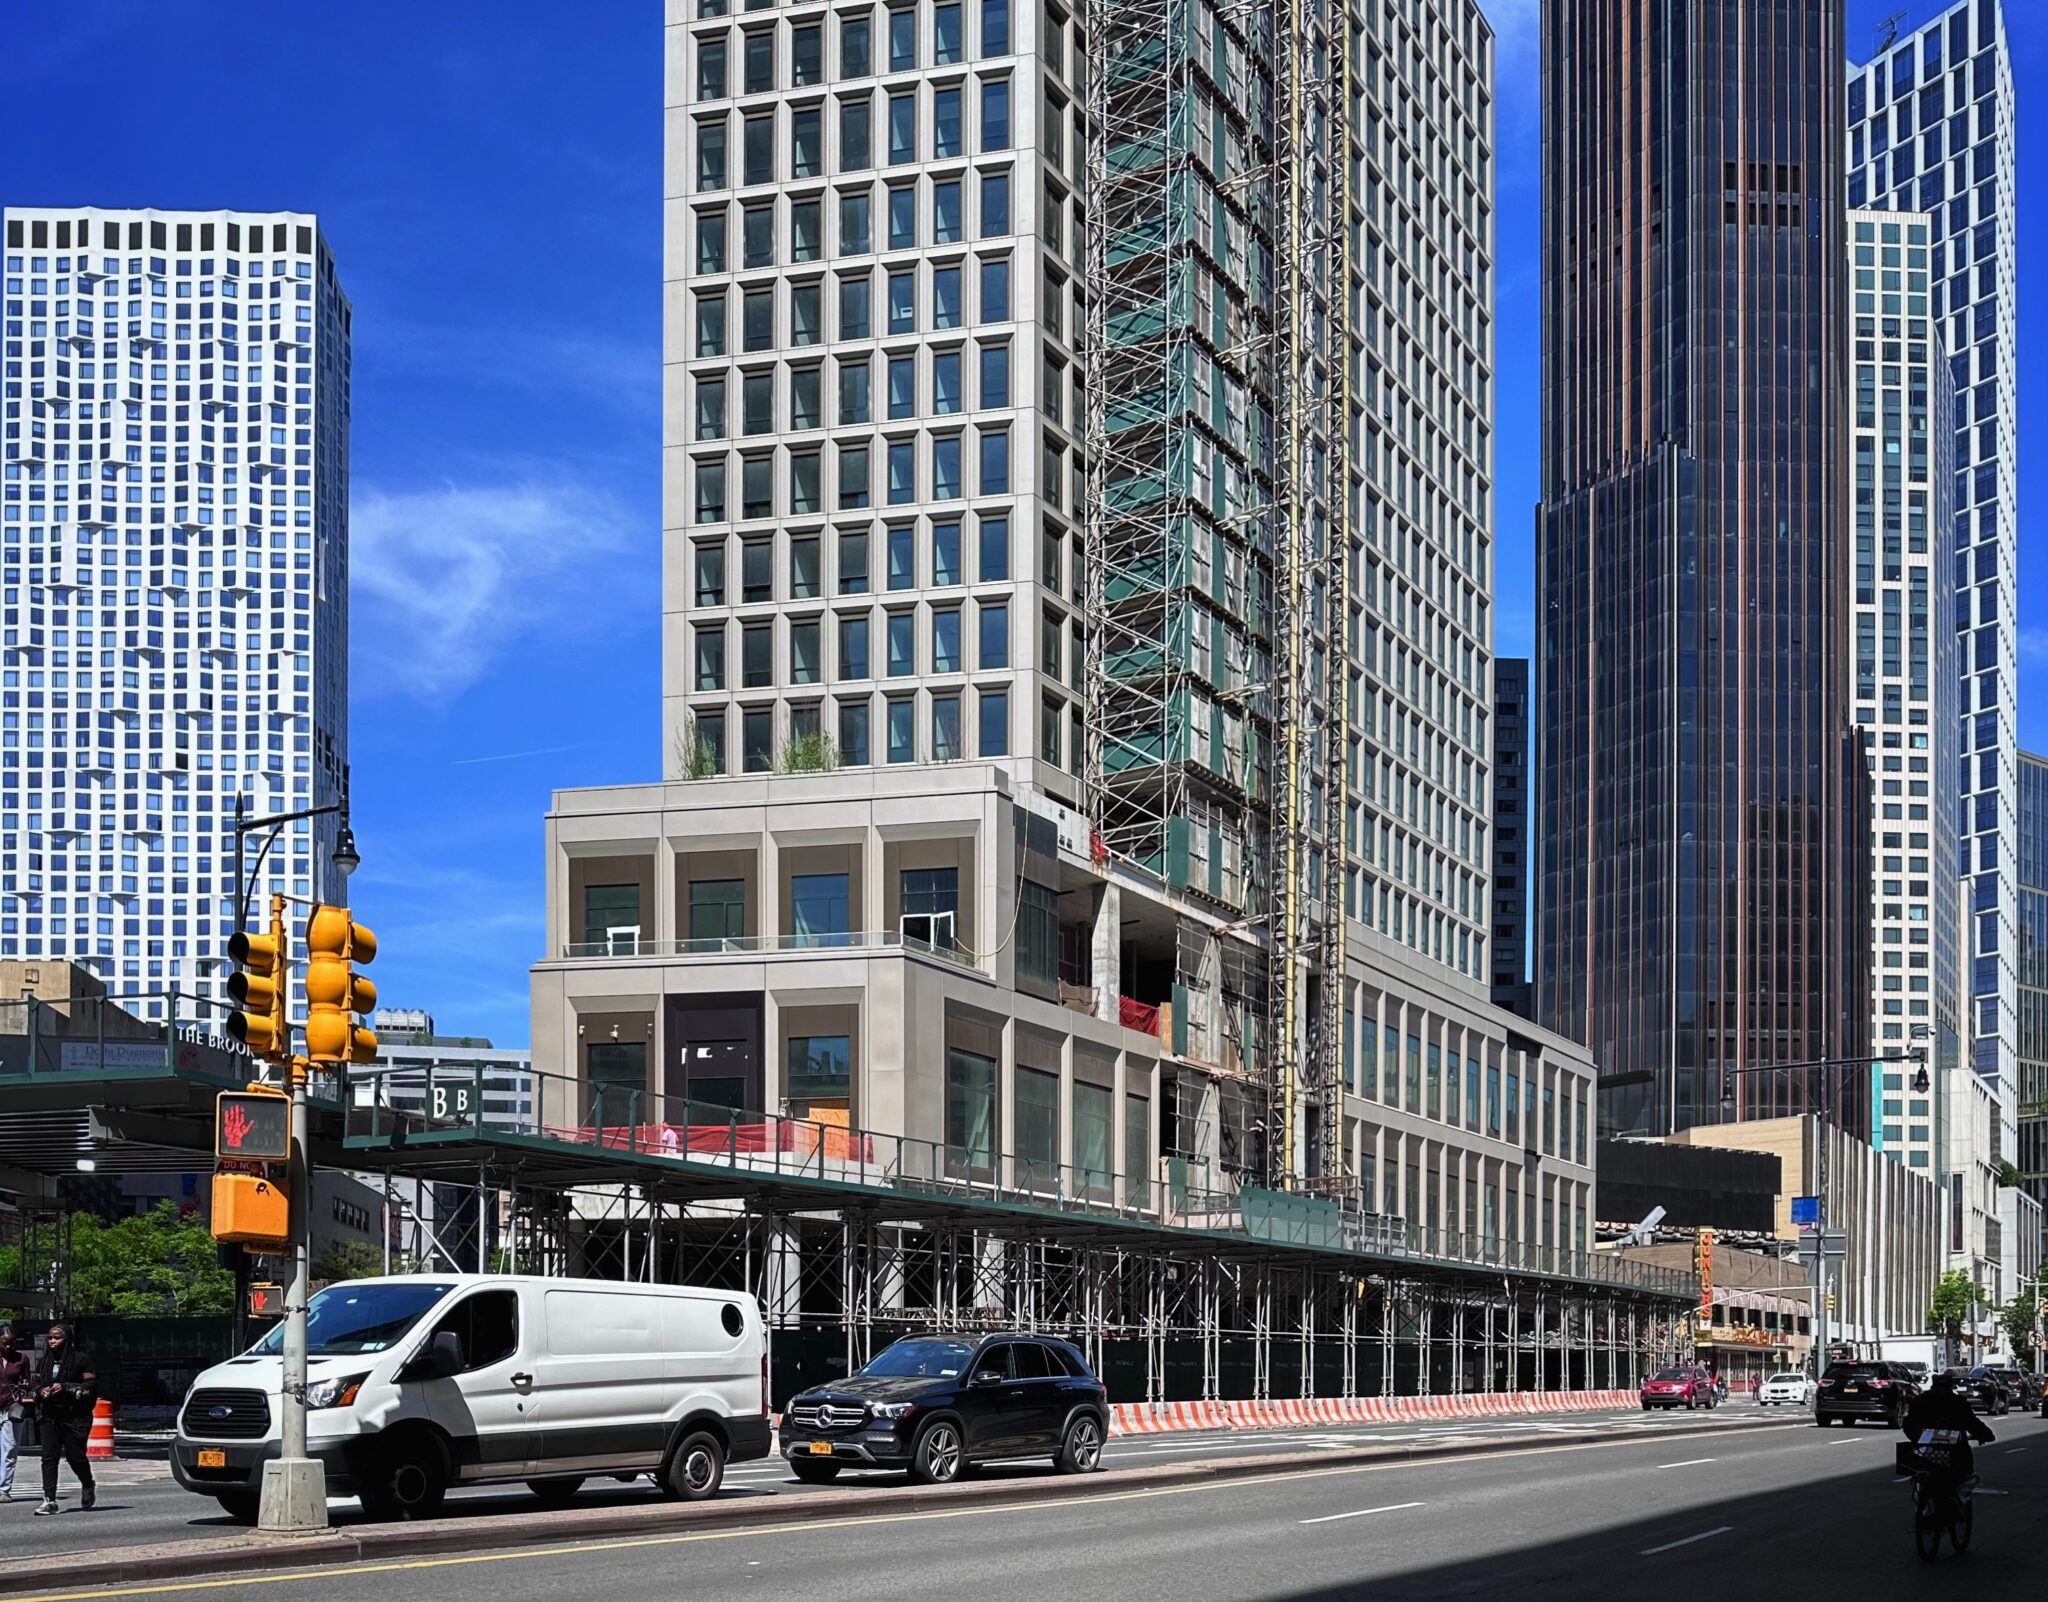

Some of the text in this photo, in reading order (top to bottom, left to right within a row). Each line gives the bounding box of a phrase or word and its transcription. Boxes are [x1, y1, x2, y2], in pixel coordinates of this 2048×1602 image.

[176, 1026, 204, 1046] THE
[433, 1086, 469, 1119] B B
[223, 1160, 237, 1170] DO
